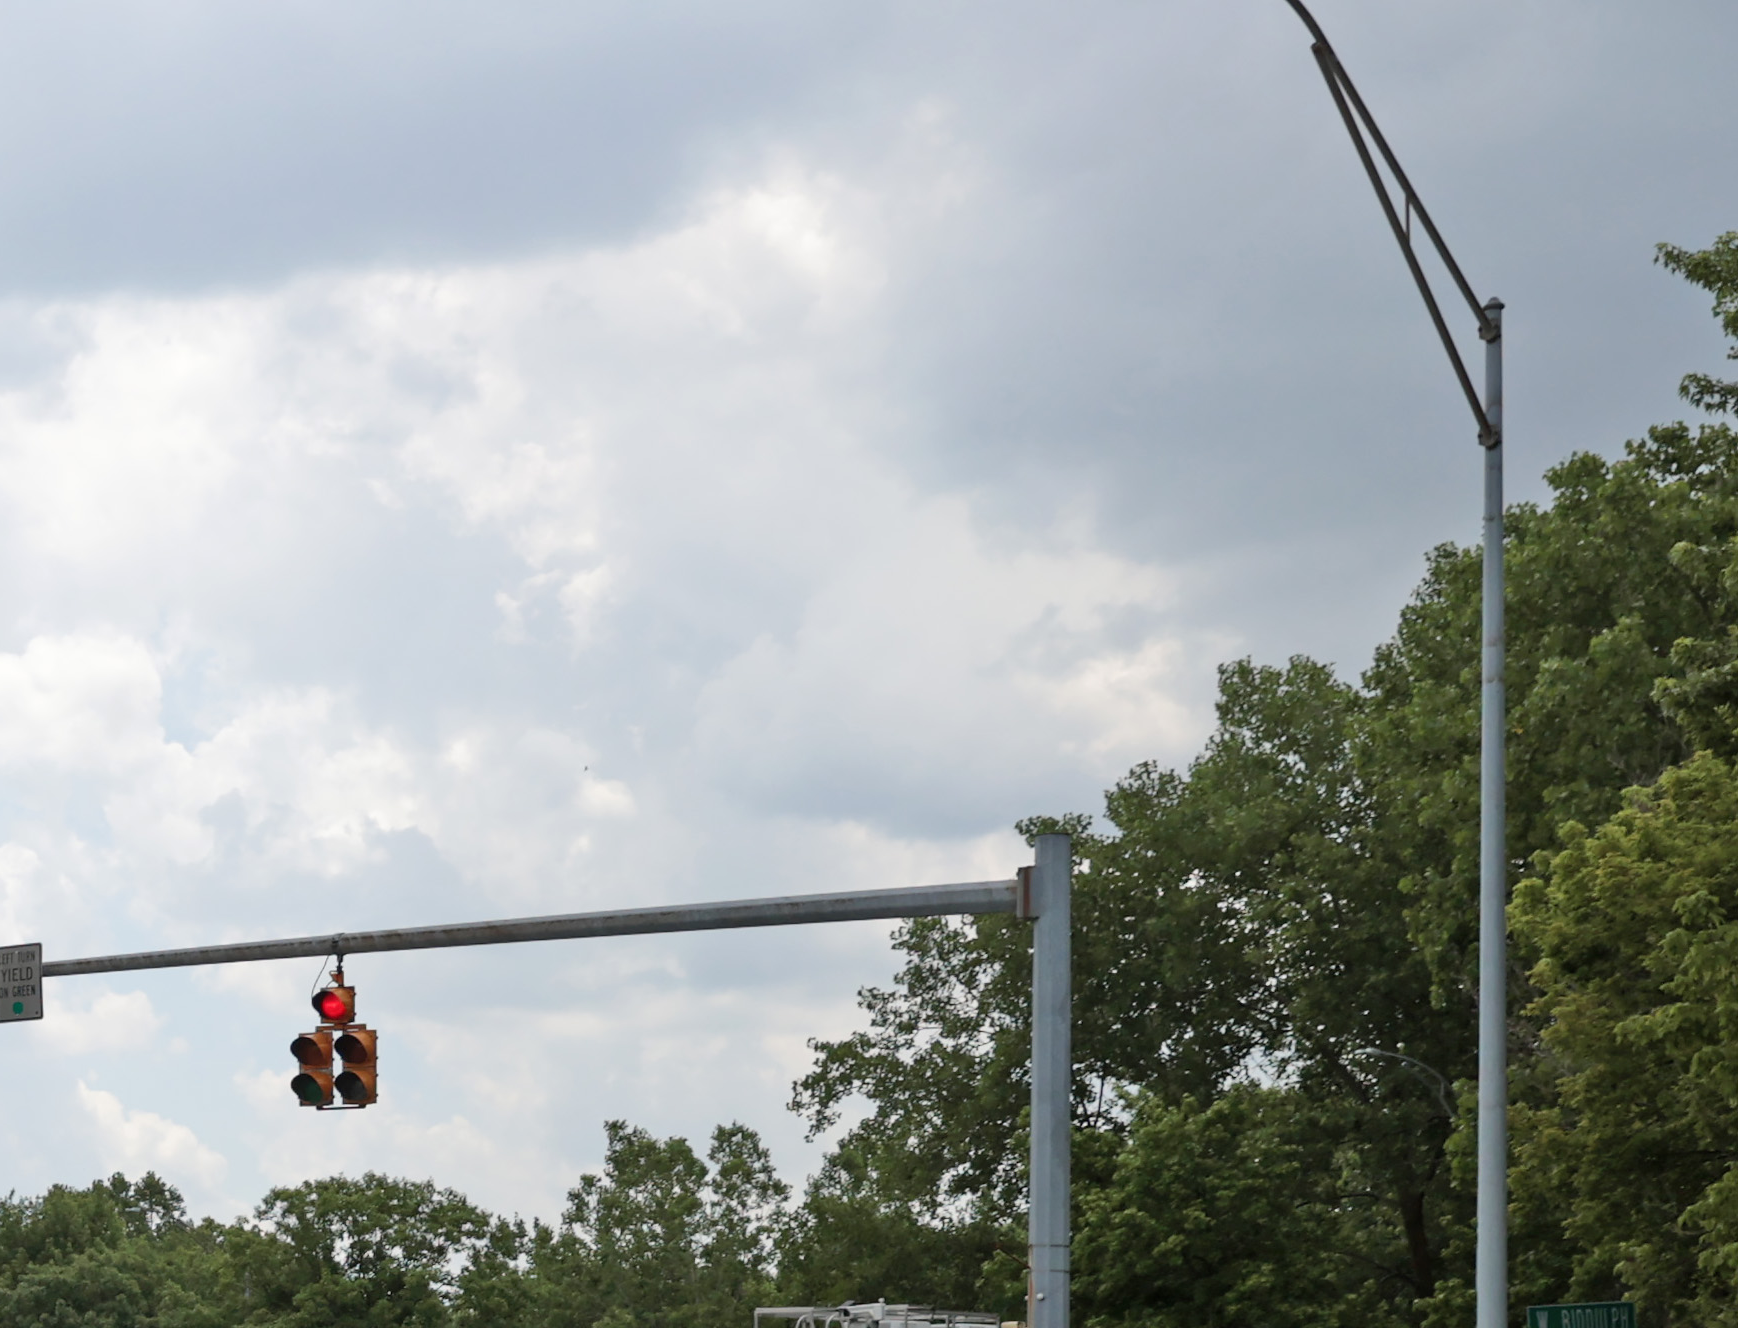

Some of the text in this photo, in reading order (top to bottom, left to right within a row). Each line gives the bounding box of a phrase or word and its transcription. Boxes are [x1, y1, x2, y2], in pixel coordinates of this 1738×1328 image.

[17, 950, 36, 963] TURN
[1, 966, 33, 983] YIELD
[12, 984, 36, 997] GREEN
